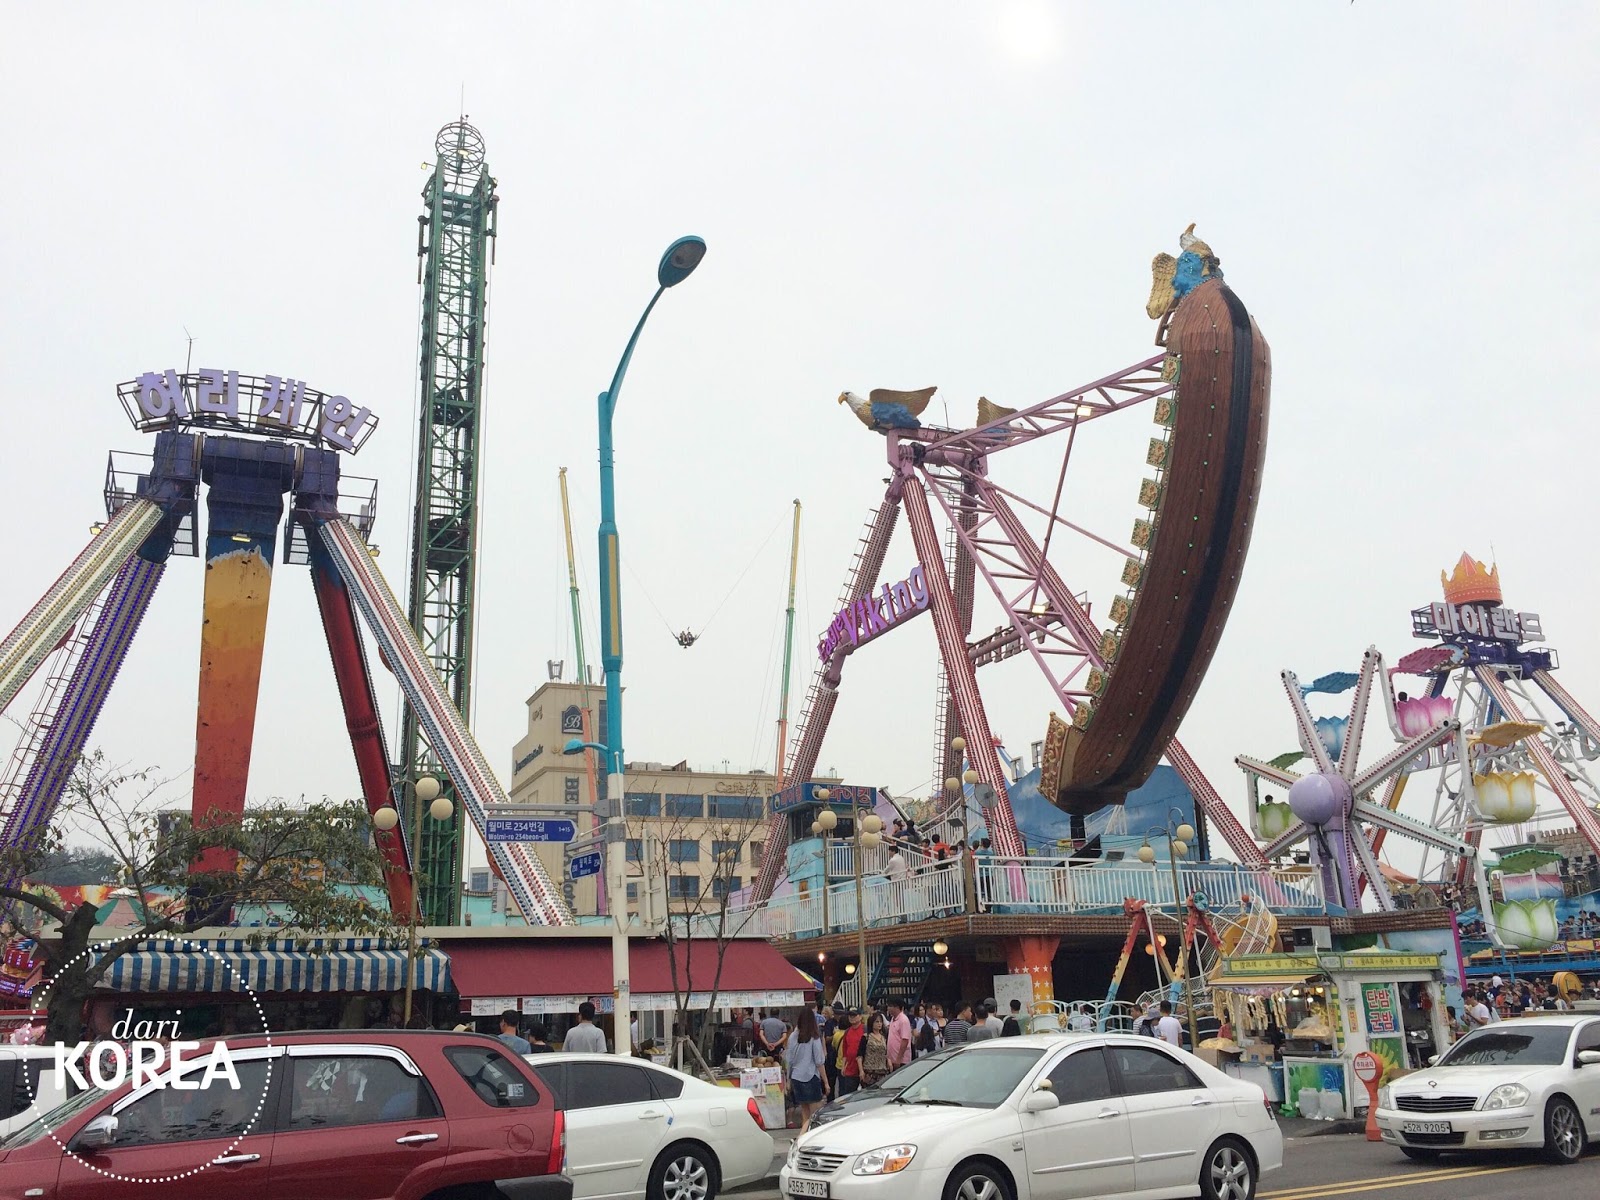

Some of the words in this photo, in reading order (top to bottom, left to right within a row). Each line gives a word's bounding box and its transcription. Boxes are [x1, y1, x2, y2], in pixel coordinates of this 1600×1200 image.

[135, 367, 372, 450] 허리케인
[840, 562, 931, 646] Viking
[1430, 601, 1546, 642] 마이랜드
[828, 785, 872, 804] 바이킹
[488, 821, 512, 832] 월미로
[513, 821, 545, 832] 234번길
[515, 834, 549, 842] 234beon-gil
[1366, 988, 1390, 1009] 단밤
[1369, 1010, 1394, 1032] 군밤
[1424, 1123, 1446, 1133] 9205
[806, 1181, 824, 1196] 7873
